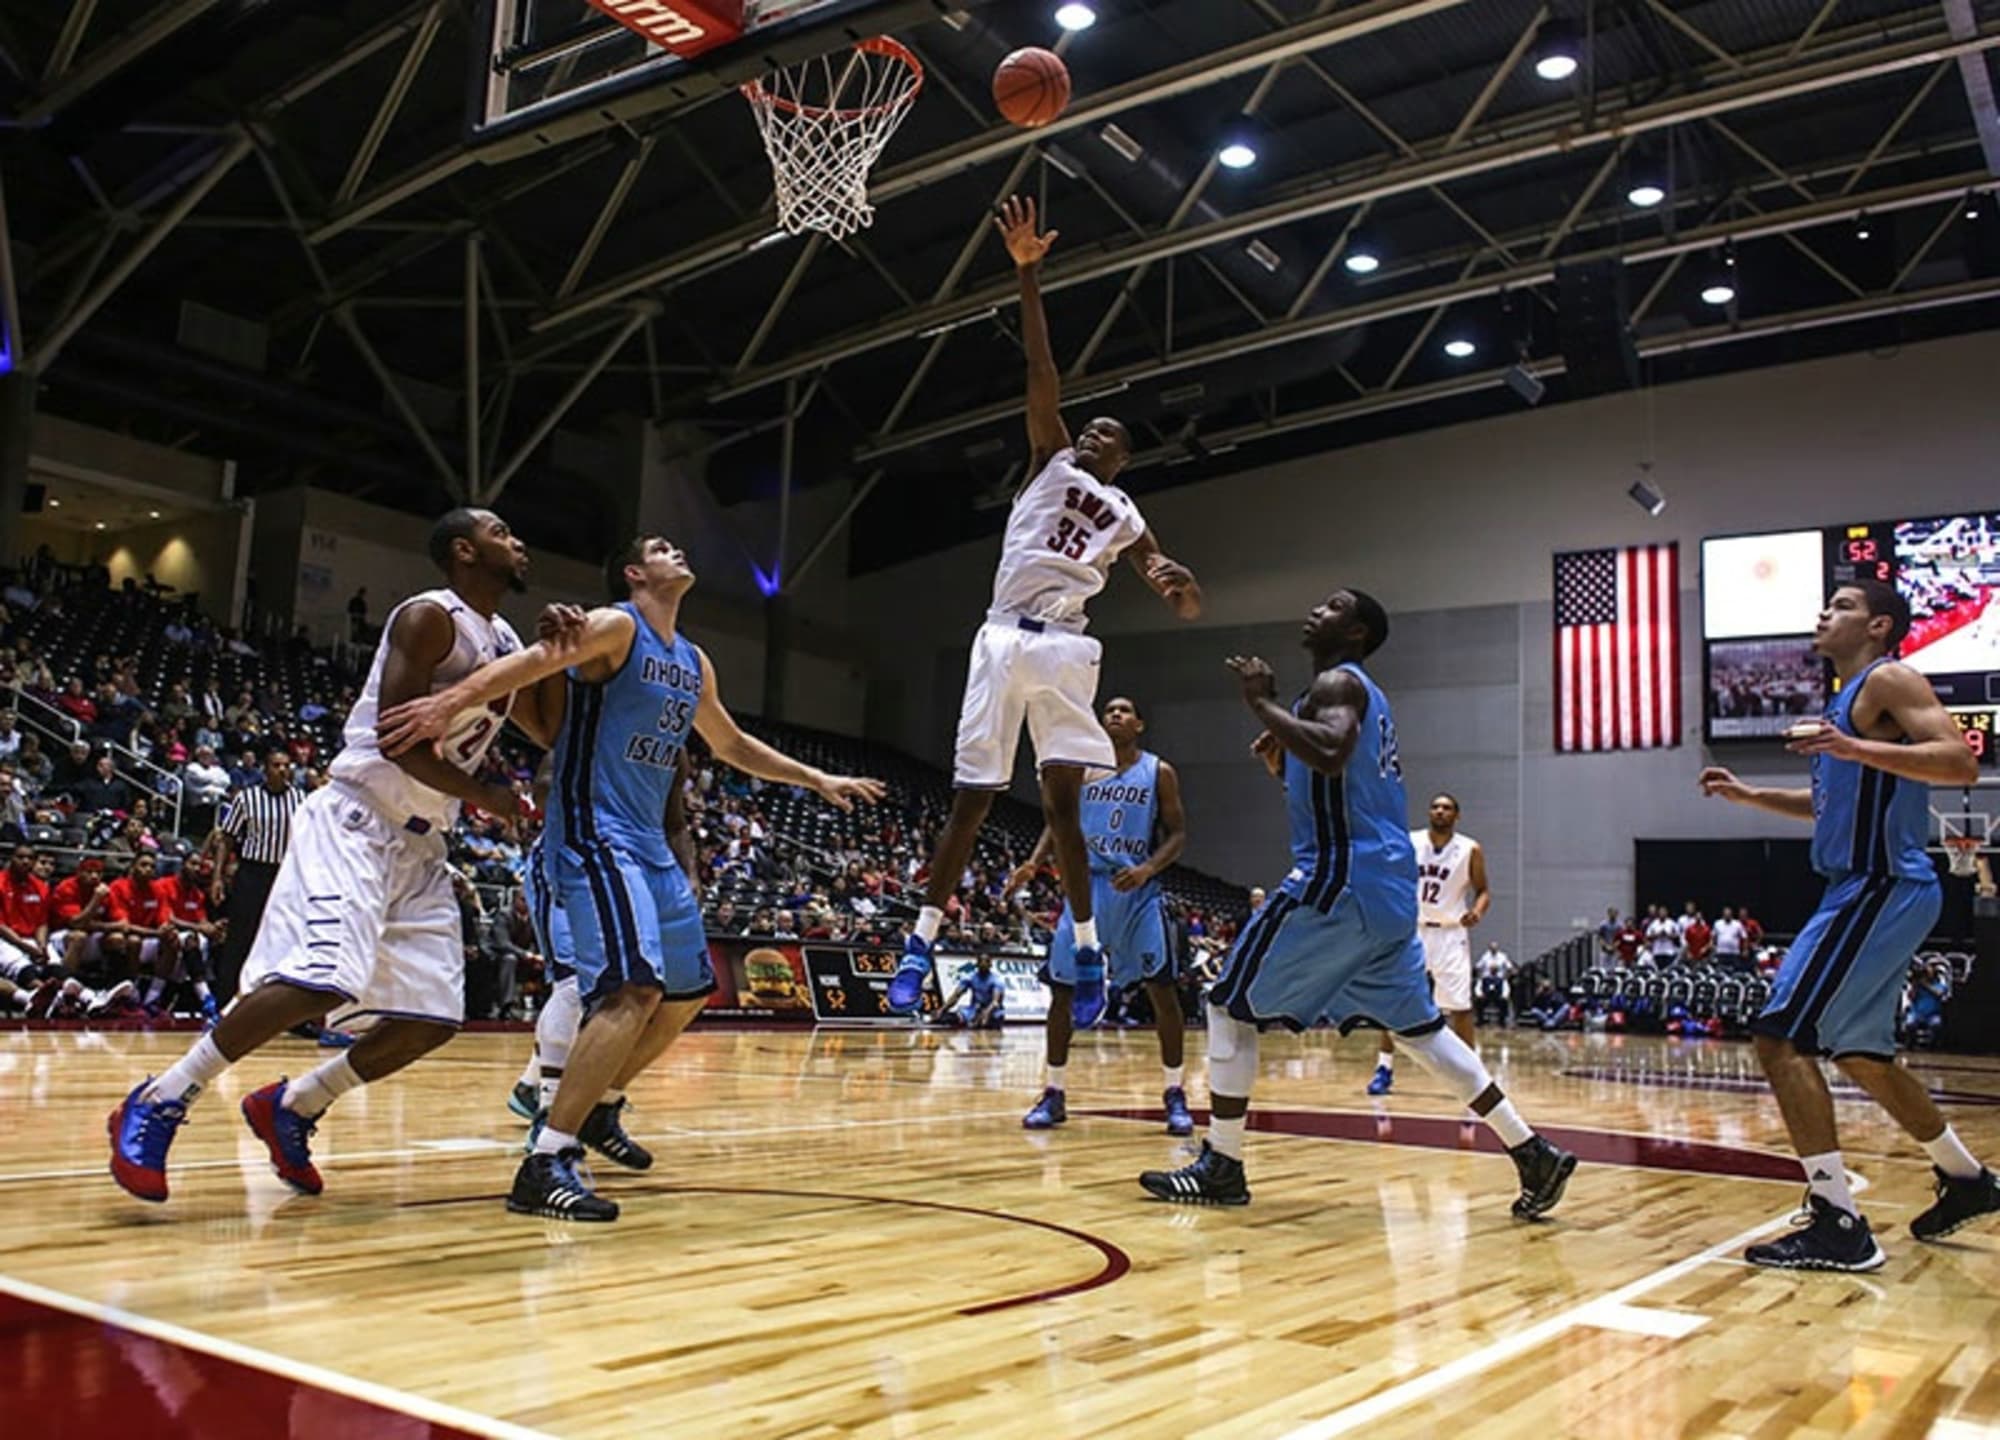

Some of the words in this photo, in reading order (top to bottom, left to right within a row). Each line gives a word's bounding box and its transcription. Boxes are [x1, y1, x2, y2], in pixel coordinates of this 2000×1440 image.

[1064, 486, 1116, 531] SMU
[1047, 517, 1091, 561] 35
[1848, 541, 1876, 561] 52
[1876, 561, 1890, 580] 2
[658, 695, 691, 736] 55
[1086, 784, 1152, 807] RHODE
[1107, 806, 1126, 833] 0
[1421, 880, 1441, 904] 12
